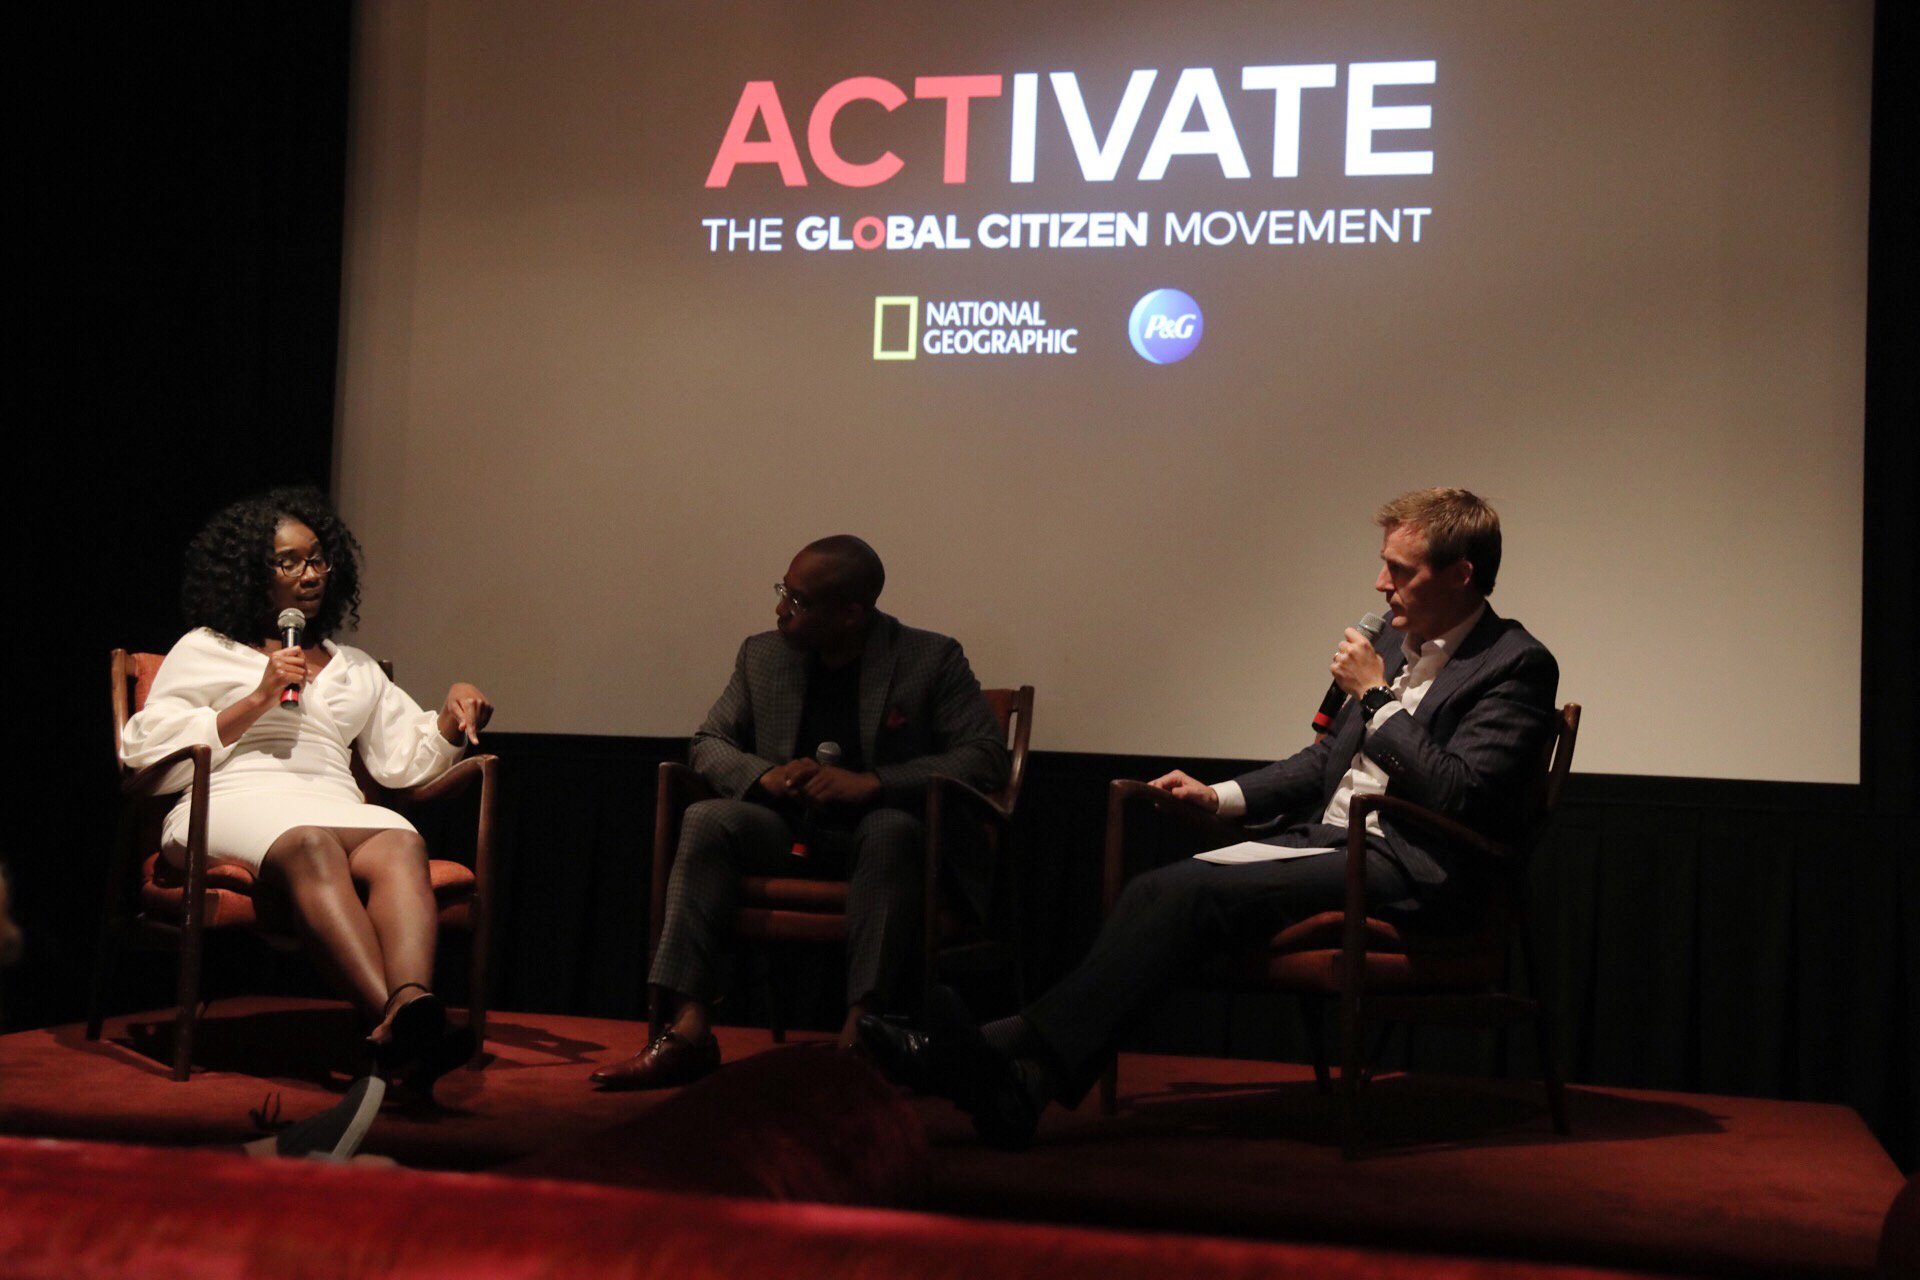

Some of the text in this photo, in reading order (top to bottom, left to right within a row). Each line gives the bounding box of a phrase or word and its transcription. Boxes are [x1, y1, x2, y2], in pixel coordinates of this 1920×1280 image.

[704, 60, 1437, 188] ACTIVATE
[701, 207, 1432, 252] THE GLOBAL CITIZEN MOVEMENT
[926, 300, 1047, 327] NATIONAL
[1144, 313, 1197, 339] P&G
[922, 327, 1079, 356] GEOGRAPHIC
